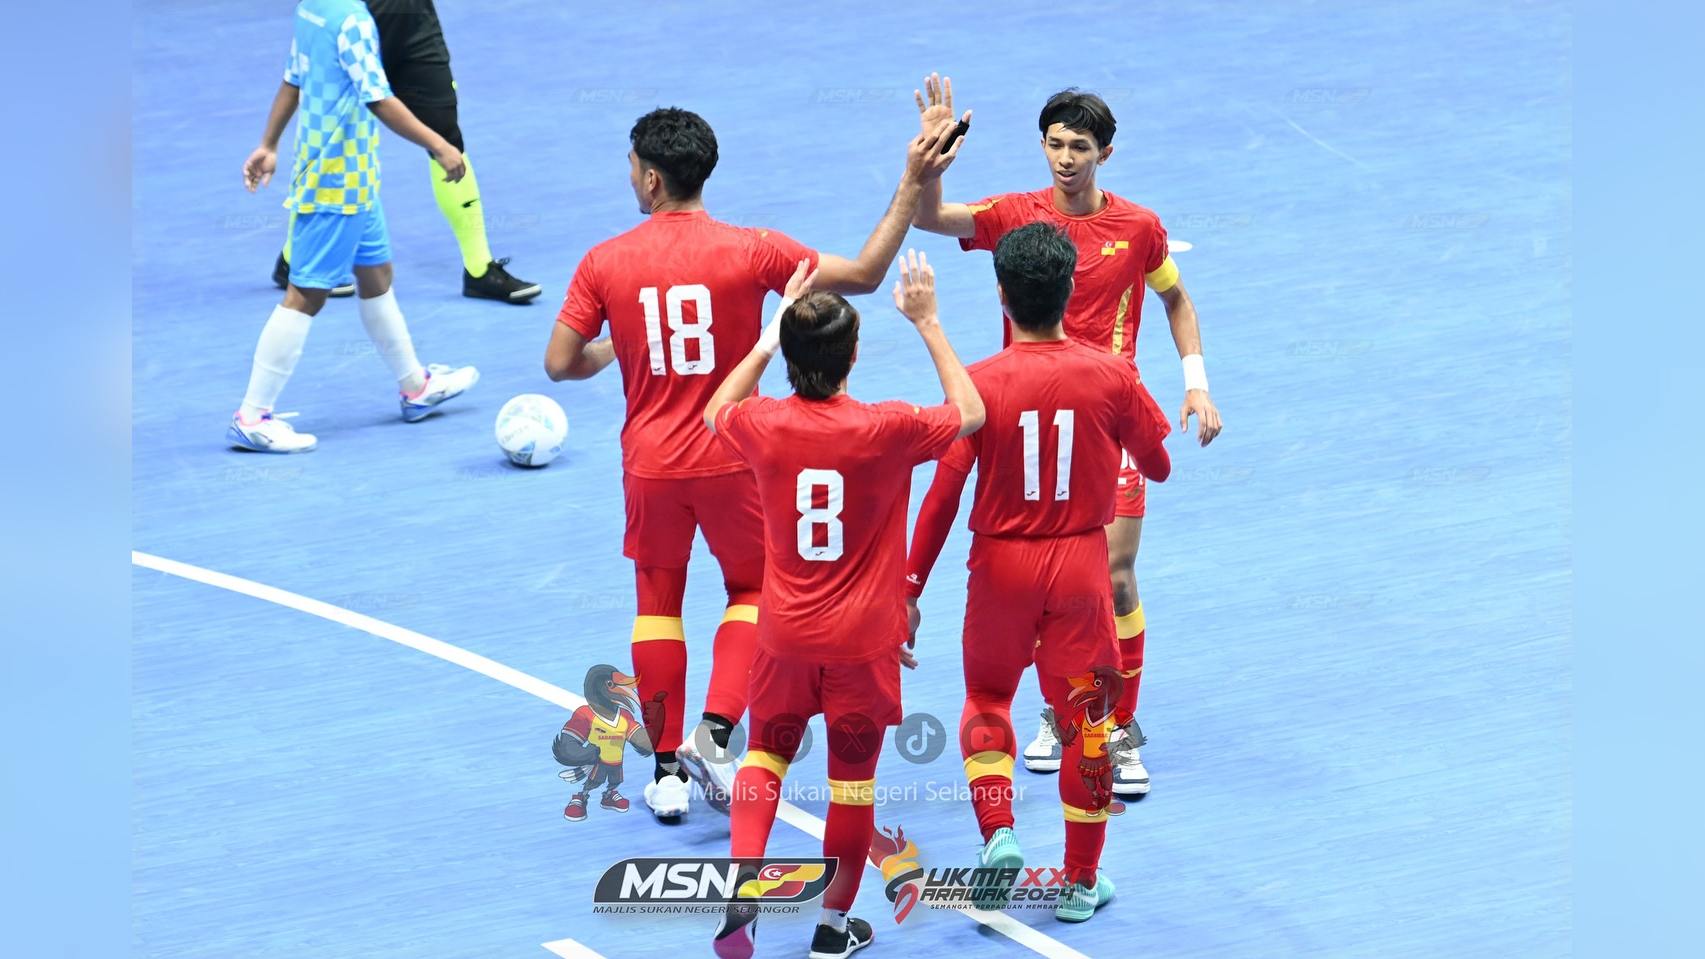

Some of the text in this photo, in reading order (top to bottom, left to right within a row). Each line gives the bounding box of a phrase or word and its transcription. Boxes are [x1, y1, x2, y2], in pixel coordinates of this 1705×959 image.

[638, 284, 715, 376] 18
[1018, 409, 1075, 501] 11
[796, 468, 844, 562] 8
